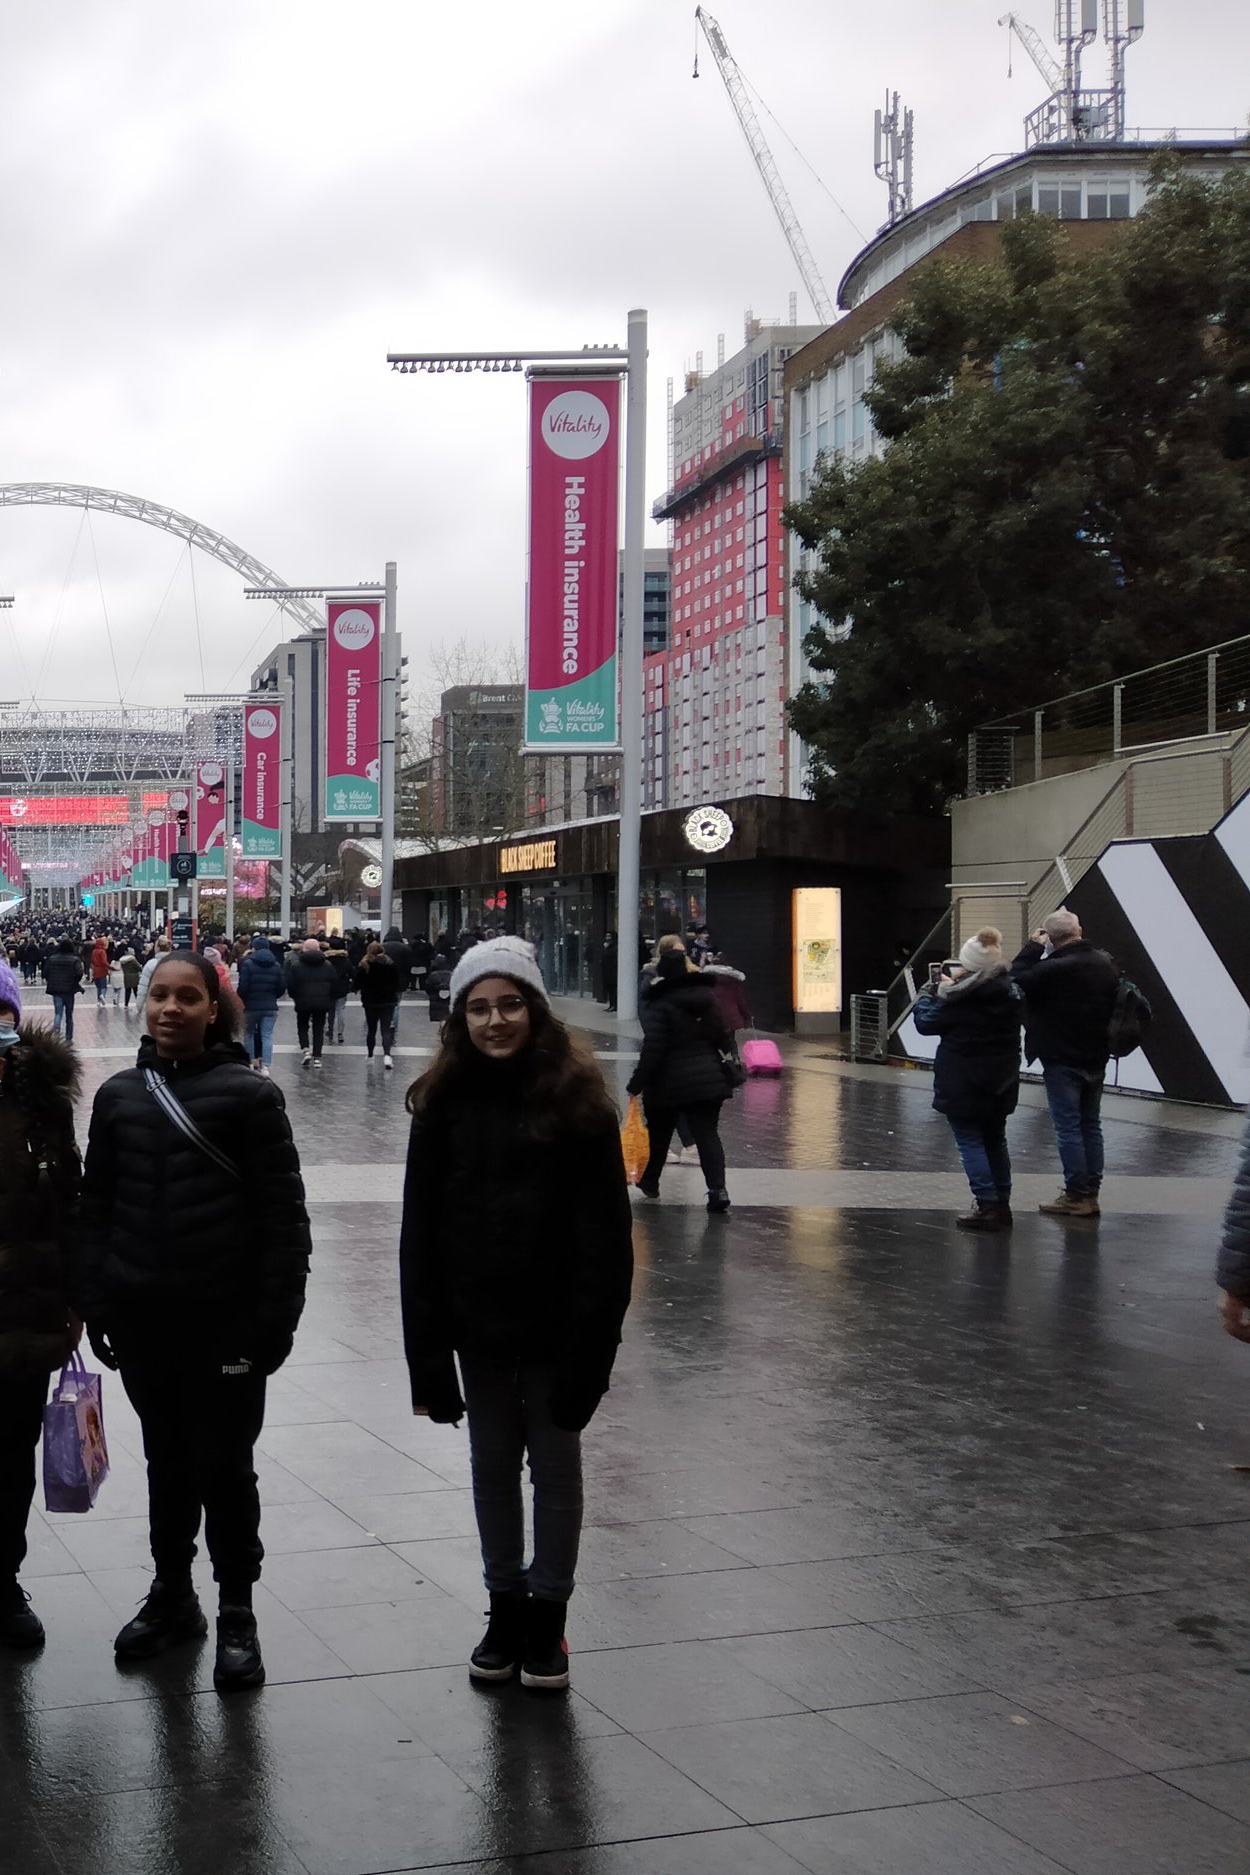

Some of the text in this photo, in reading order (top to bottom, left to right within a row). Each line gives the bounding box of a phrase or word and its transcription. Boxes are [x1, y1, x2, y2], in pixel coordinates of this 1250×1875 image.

[550, 410, 603, 436] Vitality
[562, 476, 586, 675] Health insurance
[338, 621, 370, 638] Vitality
[482, 694, 506, 703] Brent
[566, 699, 605, 720] Vitality
[346, 669, 361, 767] Life insurance
[566, 722, 605, 732] FA CUP
[256, 752, 267, 821] Car insurance
[518, 844, 535, 871] SHEEP
[534, 840, 556, 869] COFFEE
[222, 1364, 249, 1374] PUMA
